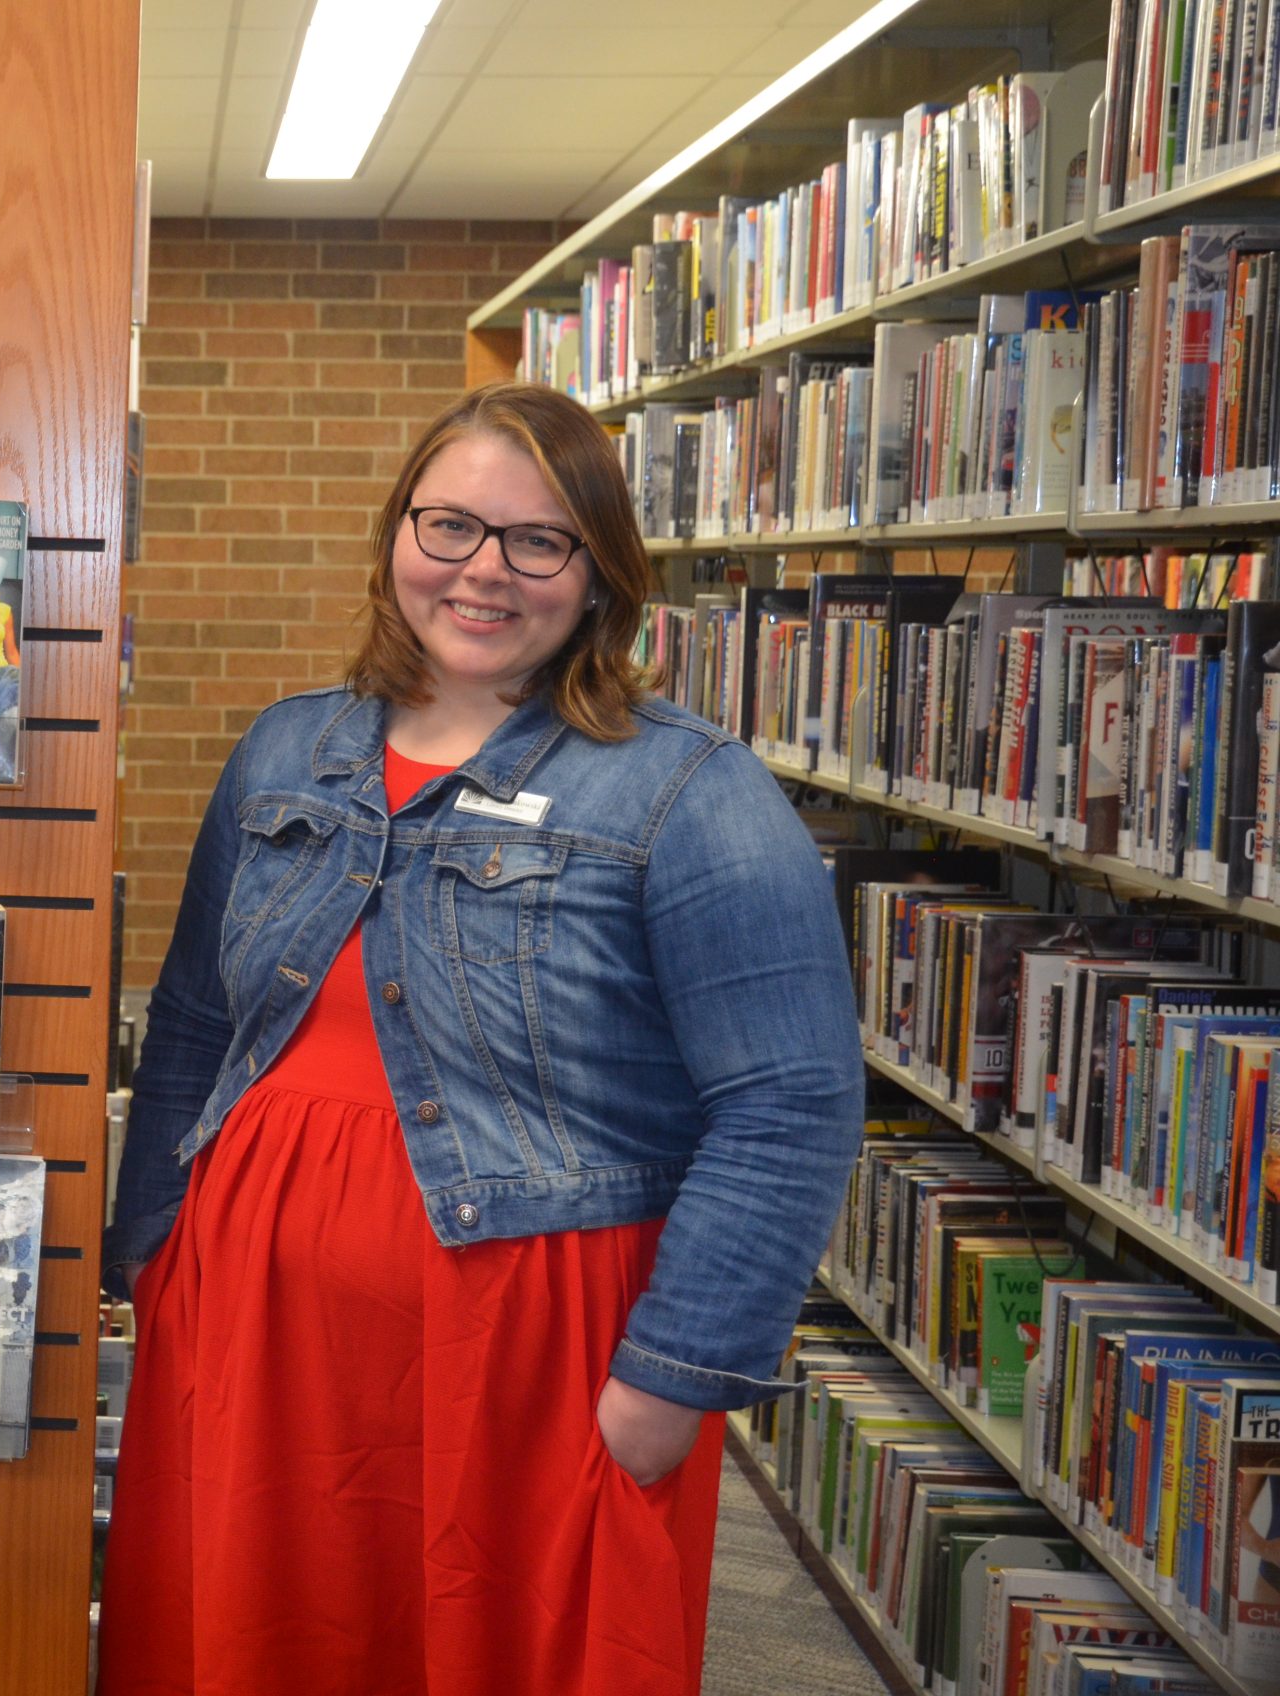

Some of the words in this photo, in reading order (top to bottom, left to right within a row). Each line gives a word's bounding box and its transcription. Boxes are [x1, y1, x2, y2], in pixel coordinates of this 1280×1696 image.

[1163, 330, 1171, 364] RON
[1160, 368, 1169, 426] SANTO
[12, 516, 21, 526] ON
[827, 604, 869, 617] BLACK
[1011, 644, 1026, 700] DREAM
[1028, 650, 1039, 690] COACH
[1008, 707, 1021, 749] TEAM
[1121, 714, 1130, 737] THE
[1120, 740, 1129, 779] TICKET
[1258, 745, 1269, 810] CURSE
[1118, 783, 1128, 806] OUT
[1158, 987, 1217, 1003] Daniels'
[1145, 996, 1153, 1044] DANIELS'
[985, 1050, 1003, 1067] 10
[1115, 1047, 1125, 1100] Women's
[1142, 1047, 1151, 1093] RUNNING
[1205, 1055, 1214, 1096] BUILD
[1112, 1102, 1122, 1157] Running
[1139, 1096, 1148, 1148] FORMULA
[1202, 1099, 1211, 1133] YOUR
[1225, 1090, 1236, 1137] Complete
[1197, 1136, 1208, 1198] RUNNING
[1223, 1139, 1233, 1166] Book
[1219, 1180, 1229, 1222] Running
[992, 1273, 1039, 1294] Twe
[1000, 1302, 1041, 1323] Yar
[1167, 1385, 1179, 1418] DUEL
[1250, 1405, 1271, 1417] THE
[1164, 1439, 1175, 1460] THE
[1165, 1424, 1175, 1436] IN
[1197, 1411, 1212, 1461] BORN
[1162, 1463, 1175, 1492] SUN
[1195, 1464, 1209, 1484] TO
[1179, 1465, 1191, 1531] NORTH
[1193, 1485, 1207, 1524] RUN
[1215, 1476, 1225, 1521] TRAINING
[1213, 1523, 1223, 1550] BIBLE
